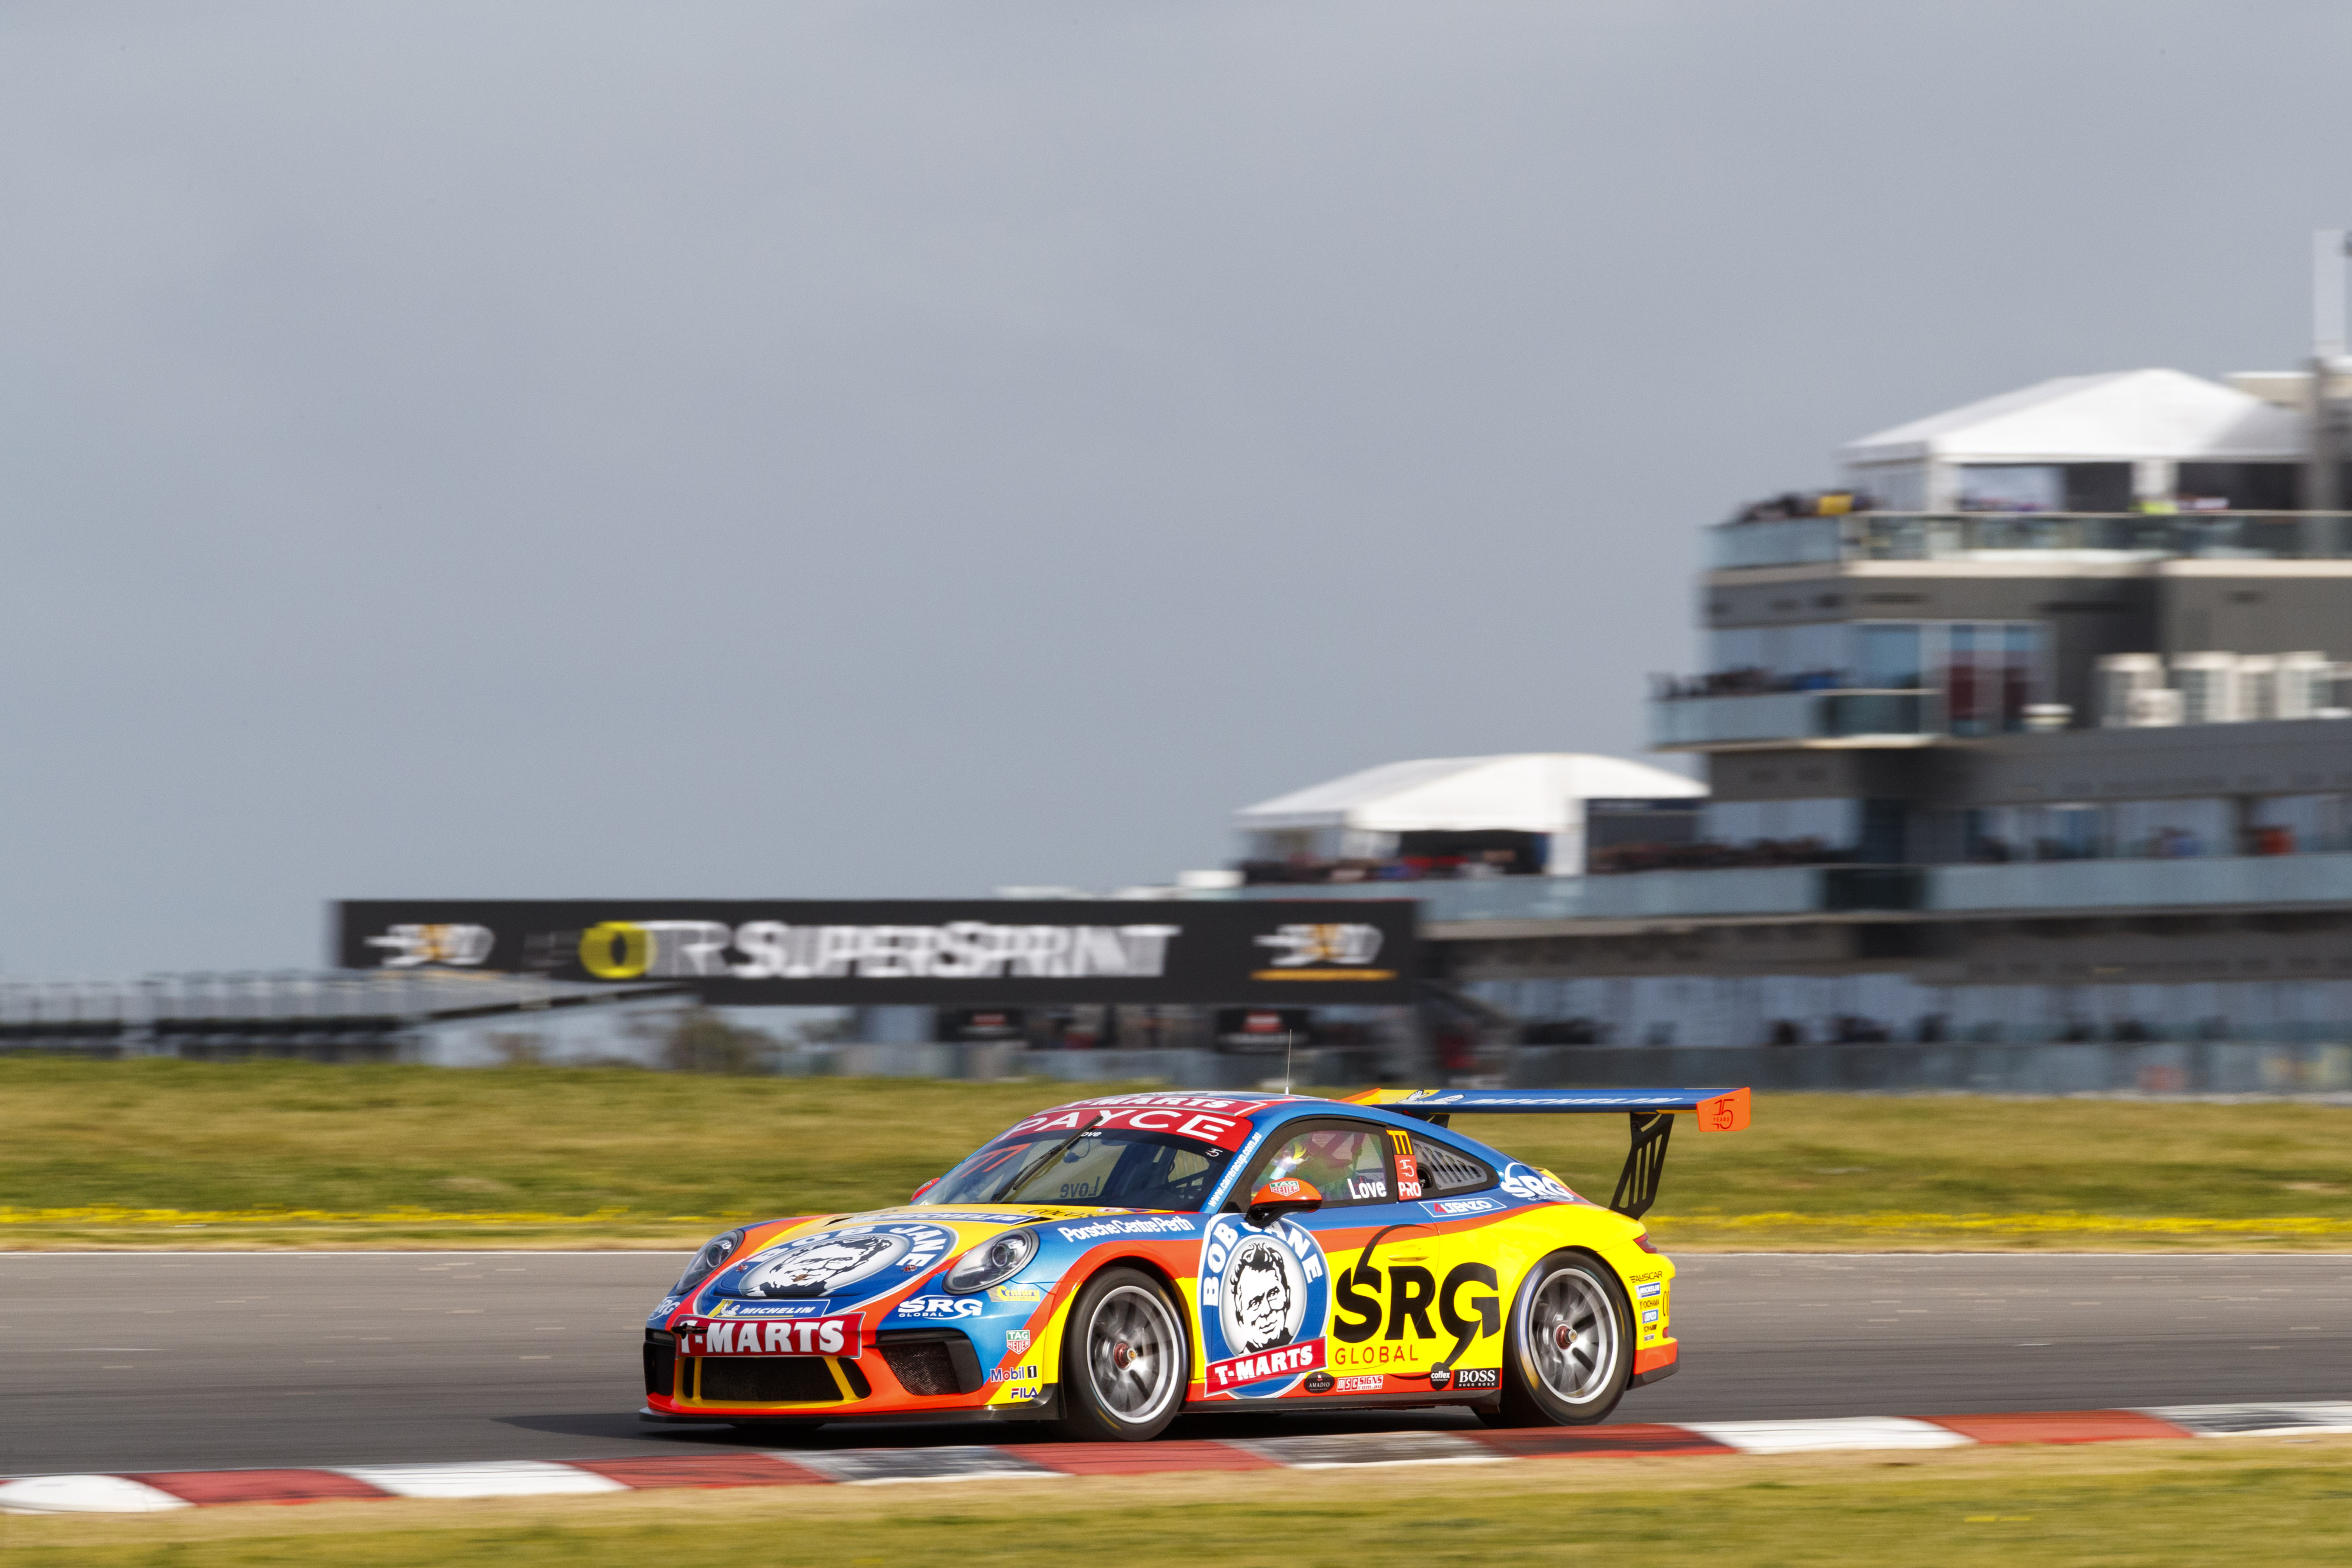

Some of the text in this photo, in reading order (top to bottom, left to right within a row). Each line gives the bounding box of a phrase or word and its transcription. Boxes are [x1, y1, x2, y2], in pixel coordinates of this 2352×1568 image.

[579, 920, 731, 979] OTR
[1063, 1096, 1237, 1109] T-MARTS
[998, 1109, 1237, 1142] PAYCE
[1386, 1129, 1413, 1155] 777
[1208, 1132, 1262, 1208] www.carreracup.com.au
[1272, 1185, 1299, 1196] HEUER
[1347, 1178, 1387, 1199] Love
[1398, 1182, 1422, 1197] PRO
[1501, 1171, 1575, 1199] SRG
[1434, 1200, 1492, 1214] ALTENZO
[1058, 1216, 1195, 1242] Porsche Centre Perth
[747, 1225, 947, 1267] BOB JANE
[1203, 1223, 1239, 1306] BOB
[653, 1298, 681, 1316] RG
[898, 1298, 983, 1317] SRG
[1334, 1259, 1501, 1344] SRG
[680, 1320, 844, 1353] T-MARTS
[1008, 1331, 1029, 1340] TAG
[1008, 1340, 1030, 1353] HEUER
[1335, 1345, 1419, 1365] GLOBAL
[991, 1365, 1036, 1382] Mobil 1
[1215, 1345, 1313, 1385] T-MARTS
[1431, 1370, 1451, 1379] coffex
[1359, 1376, 1382, 1385] SIGNS
[1459, 1370, 1495, 1383] BOSS
[1011, 1387, 1038, 1399] FILA
